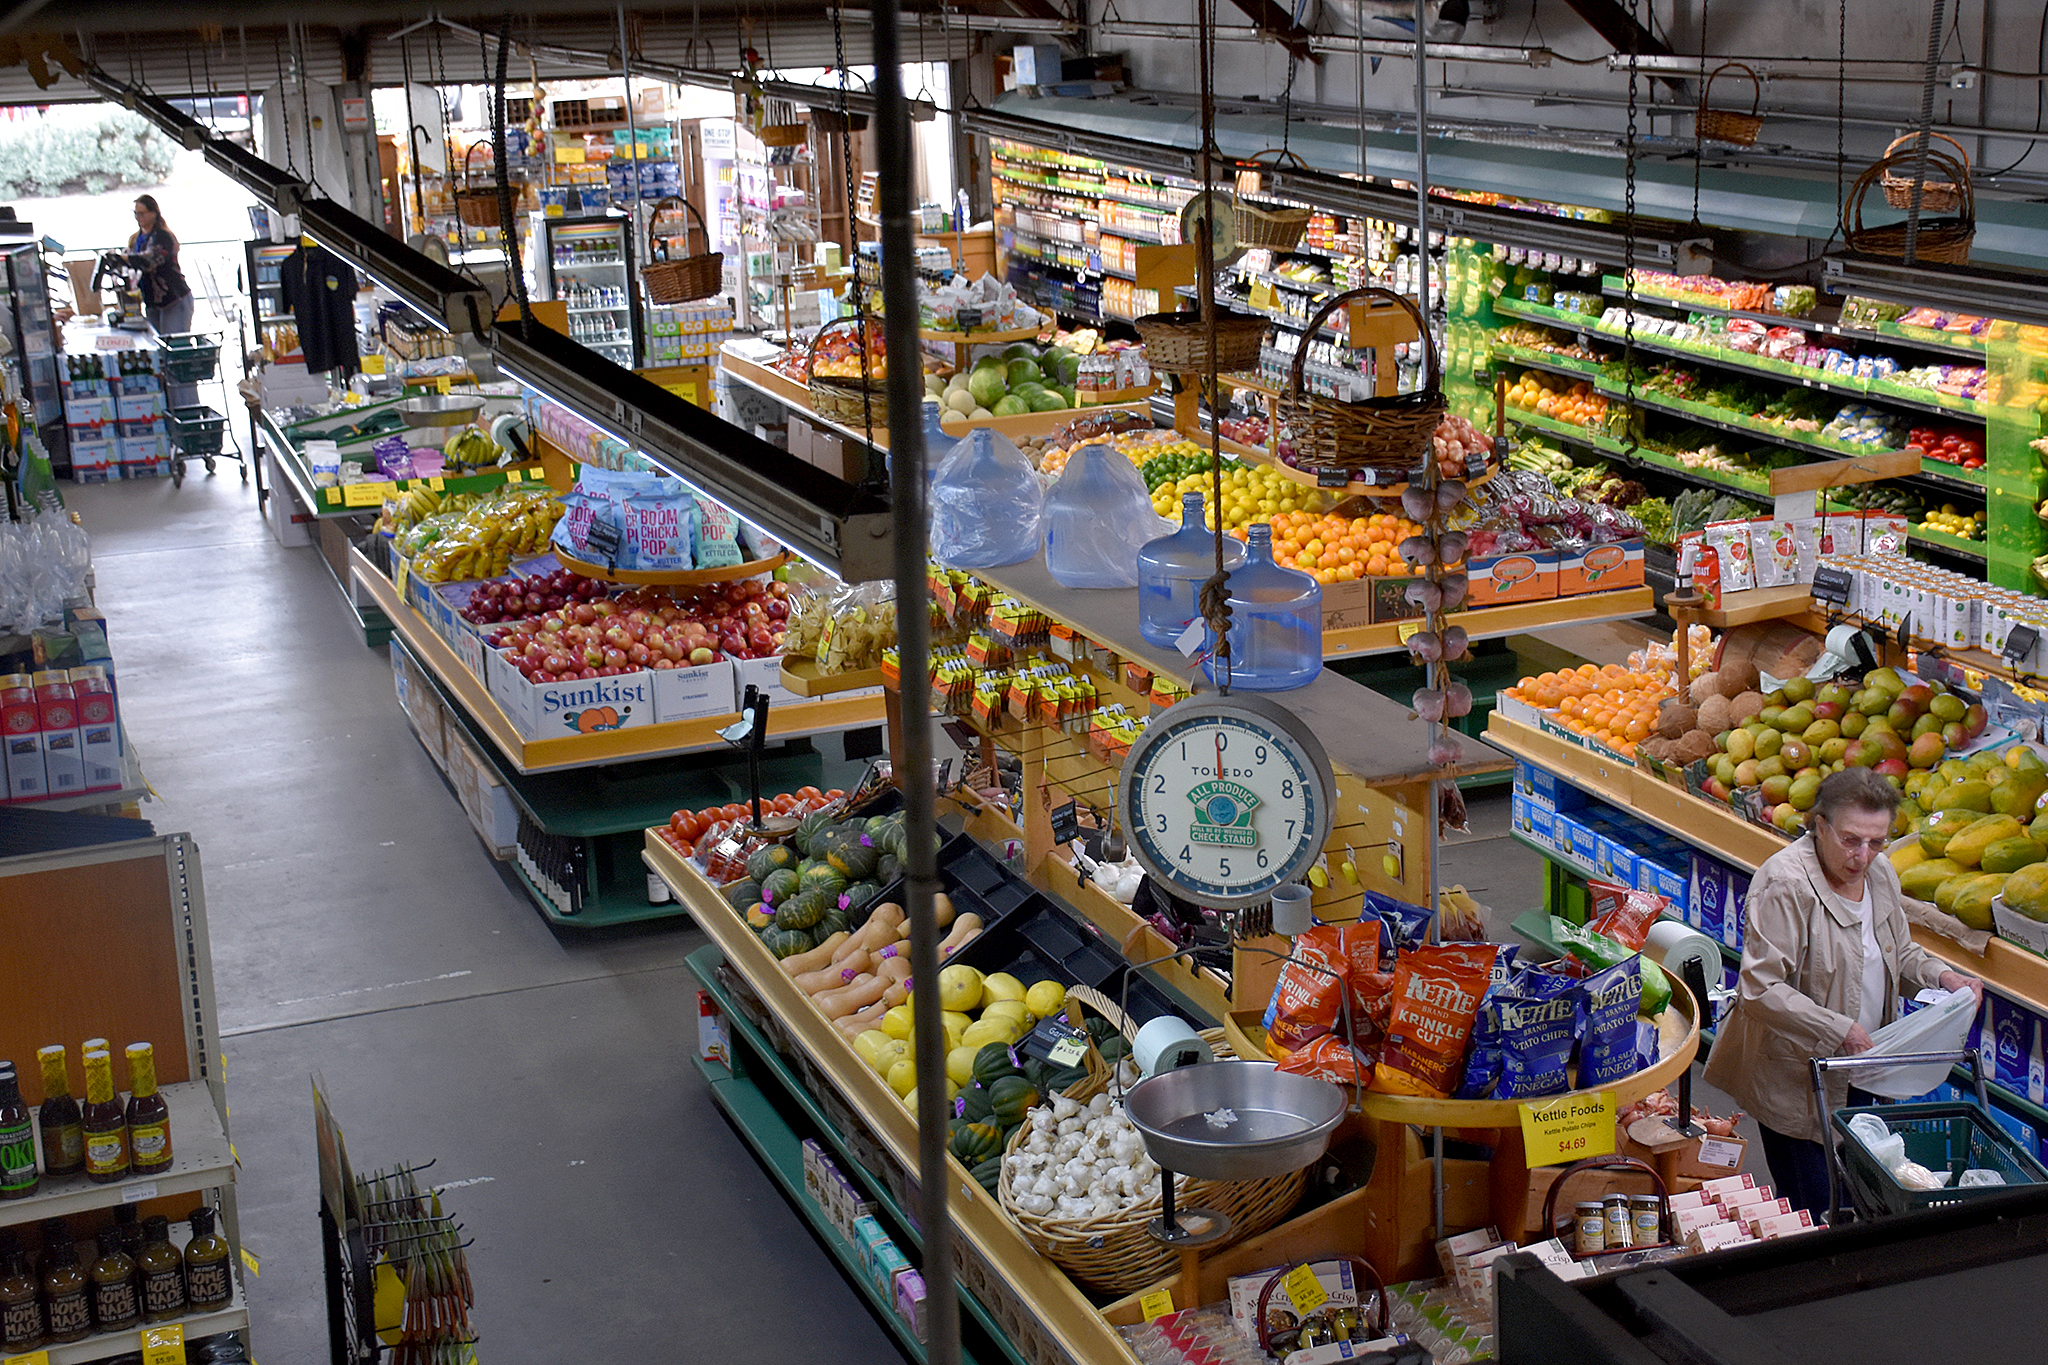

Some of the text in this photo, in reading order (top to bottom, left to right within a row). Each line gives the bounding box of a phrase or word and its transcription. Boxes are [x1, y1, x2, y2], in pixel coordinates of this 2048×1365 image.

[641, 508, 678, 526] BOOM
[641, 526, 679, 539] CHICKA
[701, 525, 726, 542] POP
[641, 538, 667, 556] POP
[1820, 573, 1844, 585] Coconuts
[678, 669, 709, 681] Sunkist
[543, 680, 646, 714] Sunkist
[1180, 741, 1186, 761] 1
[1215, 732, 1228, 752] 0
[1255, 745, 1267, 765] 9
[1191, 767, 1253, 778] TOLEDO
[1154, 774, 1166, 794] 2
[1282, 779, 1294, 799] 8
[1191, 782, 1258, 807] ALL PRODUCE
[1156, 814, 1167, 833] 3
[1284, 819, 1296, 840] 7
[1191, 832, 1253, 845] CHECK STAND
[1179, 844, 1192, 864] 4
[1257, 849, 1268, 868] 6
[1220, 858, 1231, 877] 5
[1403, 971, 1477, 1015] KETTLE
[1421, 1005, 1449, 1019] BRAND
[1498, 998, 1575, 1031] KETTLE
[1604, 1003, 1630, 1018] BRAND
[1398, 1009, 1465, 1039] KRINKLE
[1523, 1024, 1548, 1036] BRAND
[1593, 1018, 1625, 1035] POTATO
[1416, 1028, 1443, 1046] CUT
[1540, 1030, 1569, 1043] CHIPS
[1400, 1045, 1447, 1073] HABANERO
[1595, 1051, 1638, 1079] VINEGA
[1602, 1056, 1618, 1066] SEA
[1514, 1074, 1532, 1082] SEA
[1534, 1070, 1553, 1080] SALT
[1951, 1087, 1960, 1099] 12
[1532, 1103, 1605, 1123] Kettle Foods
[1544, 1128, 1560, 1136] Kettle
[1561, 1124, 1580, 1133] Potato
[1580, 1121, 1597, 1129] Chips
[2021, 1125, 2031, 1138] 12
[1558, 1137, 1586, 1152] $4.69
[1549, 1254, 1571, 1265] Crisp
[146, 1275, 182, 1293] HOME
[189, 1268, 225, 1284] HOME
[97, 1285, 133, 1304] HOME
[147, 1287, 184, 1305] MADE
[190, 1280, 227, 1297] MADE
[1331, 1291, 1355, 1304] Crisp
[3, 1303, 41, 1324] HOME
[49, 1296, 89, 1316] HOME
[98, 1297, 136, 1316] MADE
[4, 1316, 43, 1337] MADE
[51, 1308, 90, 1328] MADE
